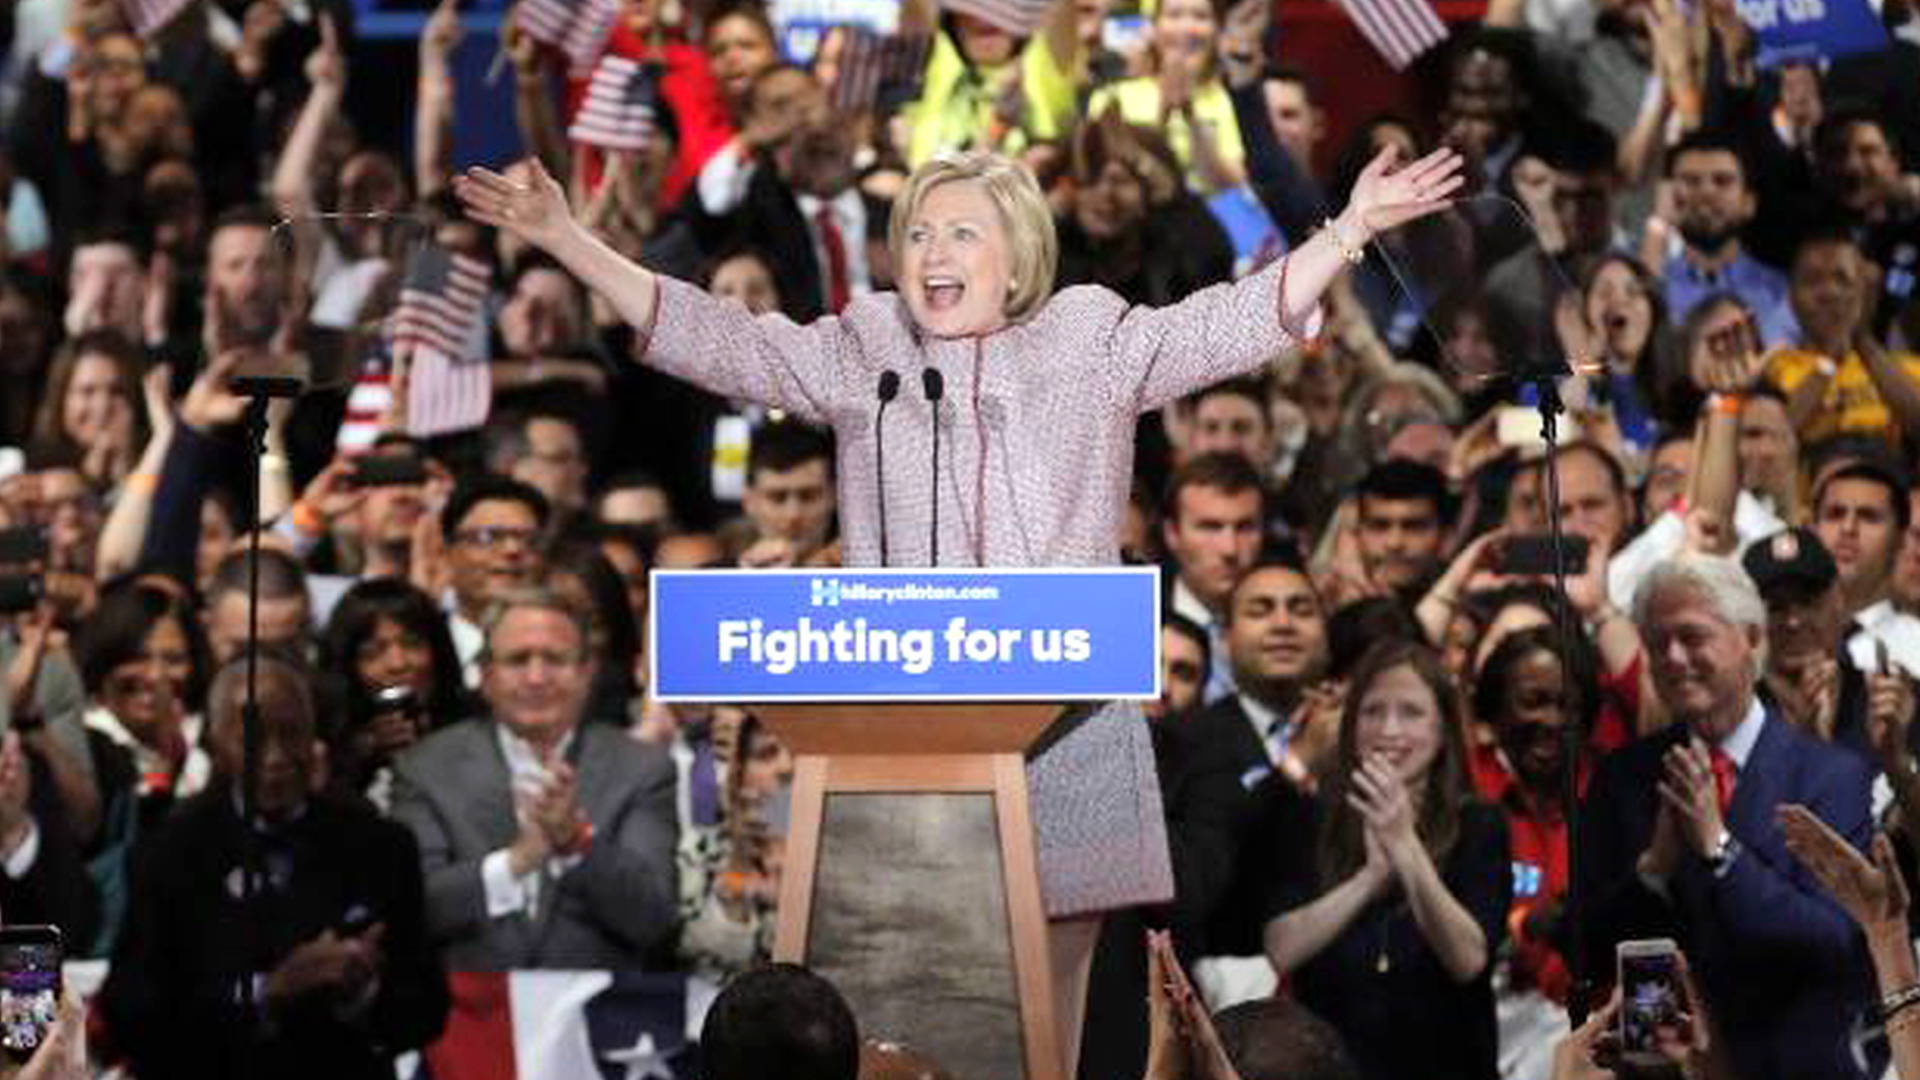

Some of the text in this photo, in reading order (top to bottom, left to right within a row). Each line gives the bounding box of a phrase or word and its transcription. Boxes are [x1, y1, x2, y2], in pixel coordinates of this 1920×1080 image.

[840, 583, 999, 605] hillaryclinton.com
[718, 617, 1091, 674] Fighting for us
